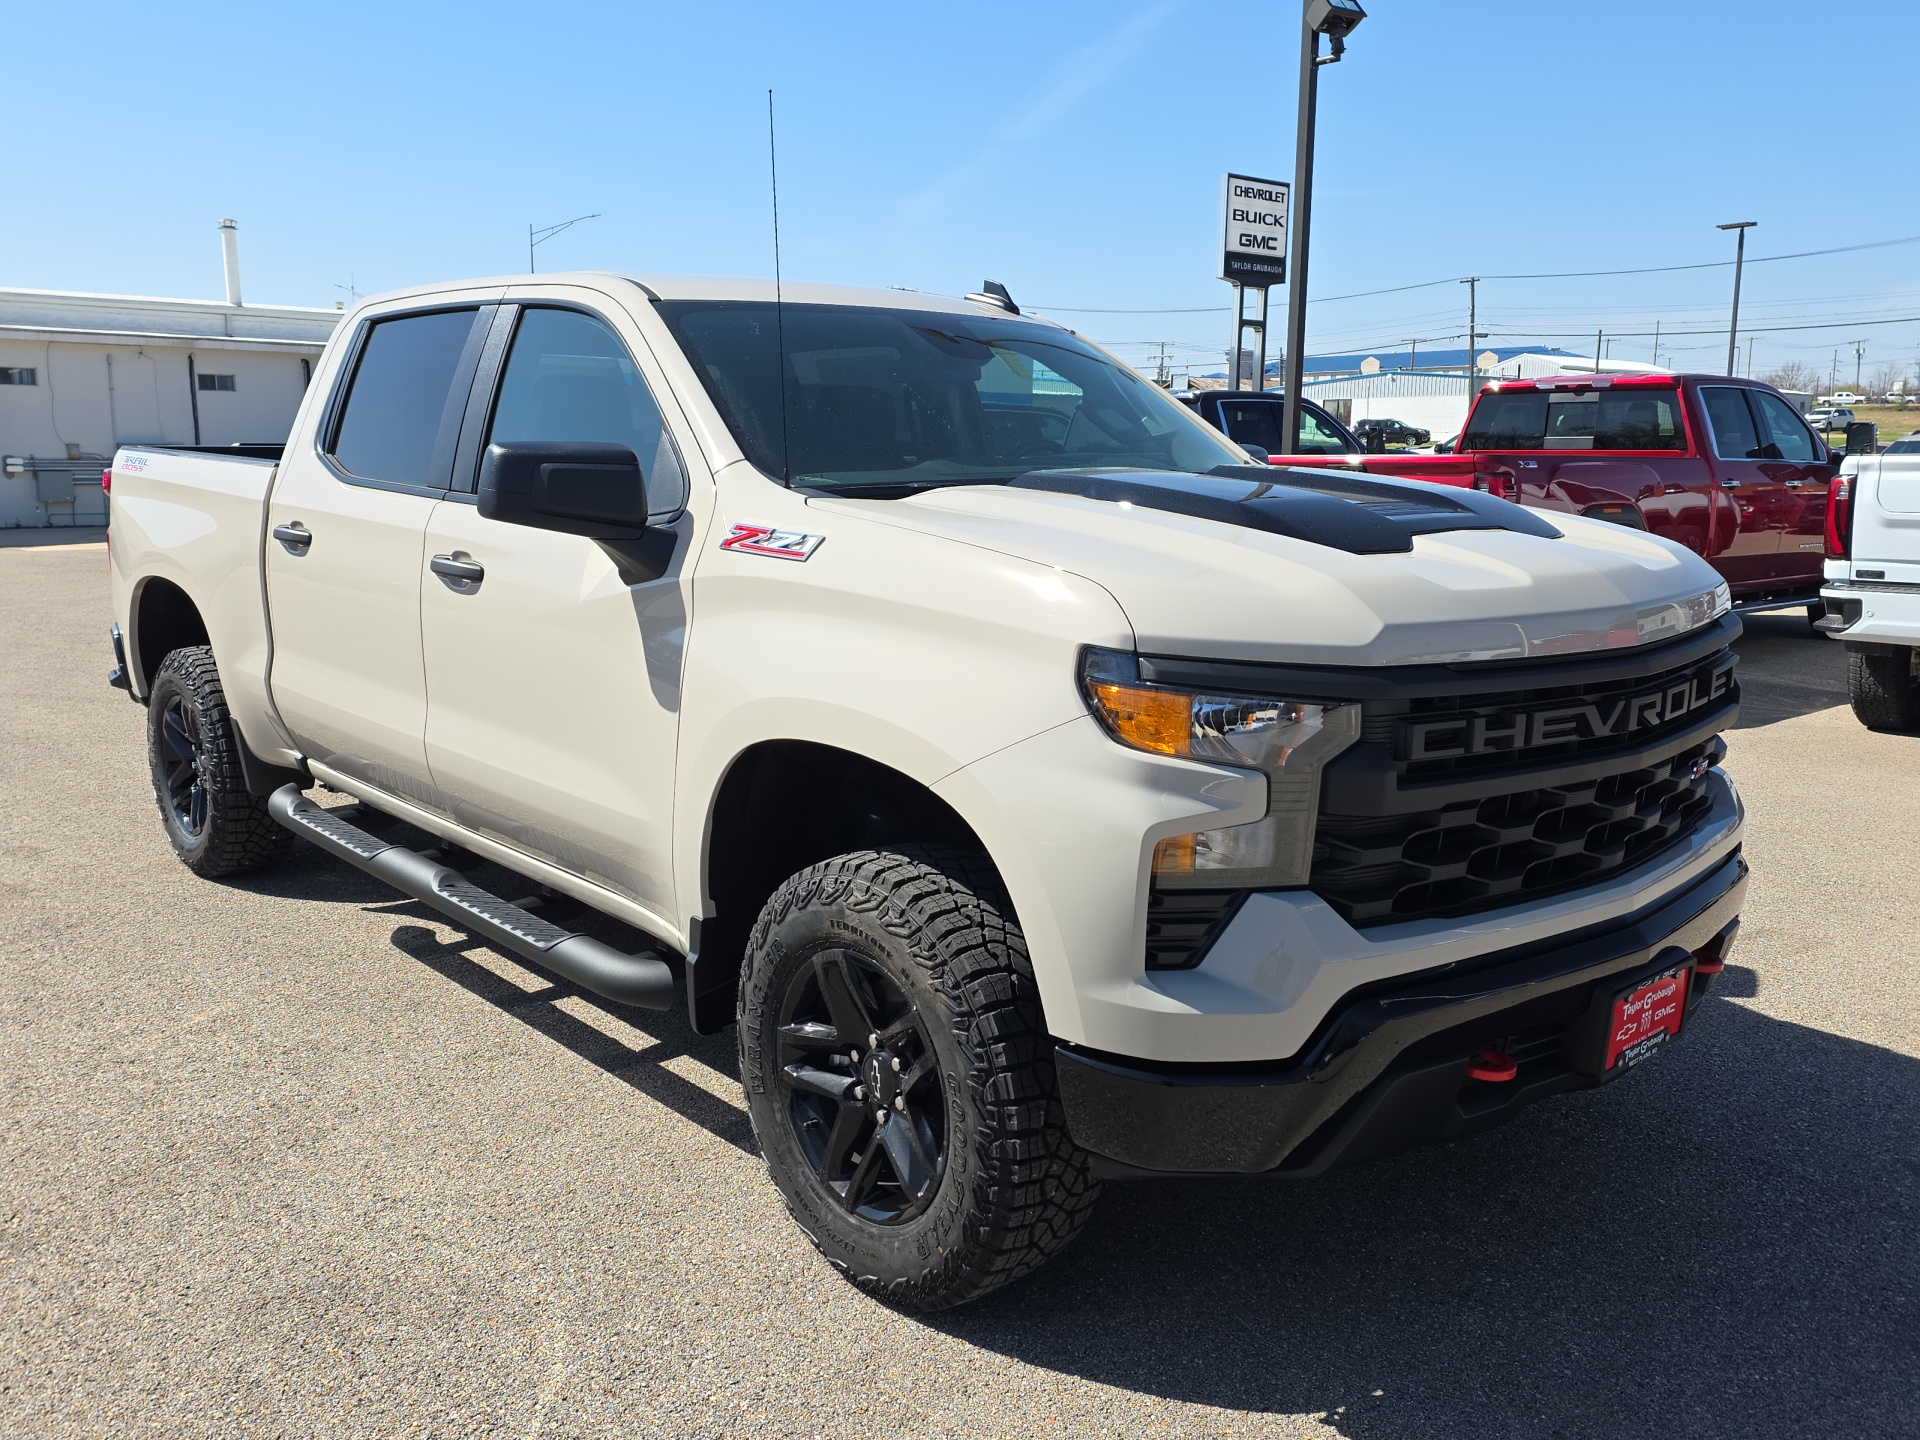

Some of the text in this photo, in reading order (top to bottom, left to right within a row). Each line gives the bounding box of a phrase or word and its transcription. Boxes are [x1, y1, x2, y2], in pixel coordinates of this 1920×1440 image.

[1234, 185, 1286, 204] CHEVROLET
[1232, 208, 1285, 228] BUICK
[1239, 233, 1278, 251] GMC
[1231, 261, 1283, 274] TAYLOR GRUBAUGH
[121, 463, 145, 473] BOSS
[124, 455, 149, 467] TRAIL
[719, 522, 826, 562] Z71
[1410, 658, 1739, 761] CHEVROLET
[829, 918, 894, 959] TERRITORY
[1623, 982, 1677, 1021] Taylor Grubaugh
[1654, 1002, 1677, 1020] GMC
[747, 937, 787, 1095] WRANGLER
[1625, 1032, 1665, 1063] Taylor Grubaugh
[915, 1070, 968, 1262] GOODYEAR
